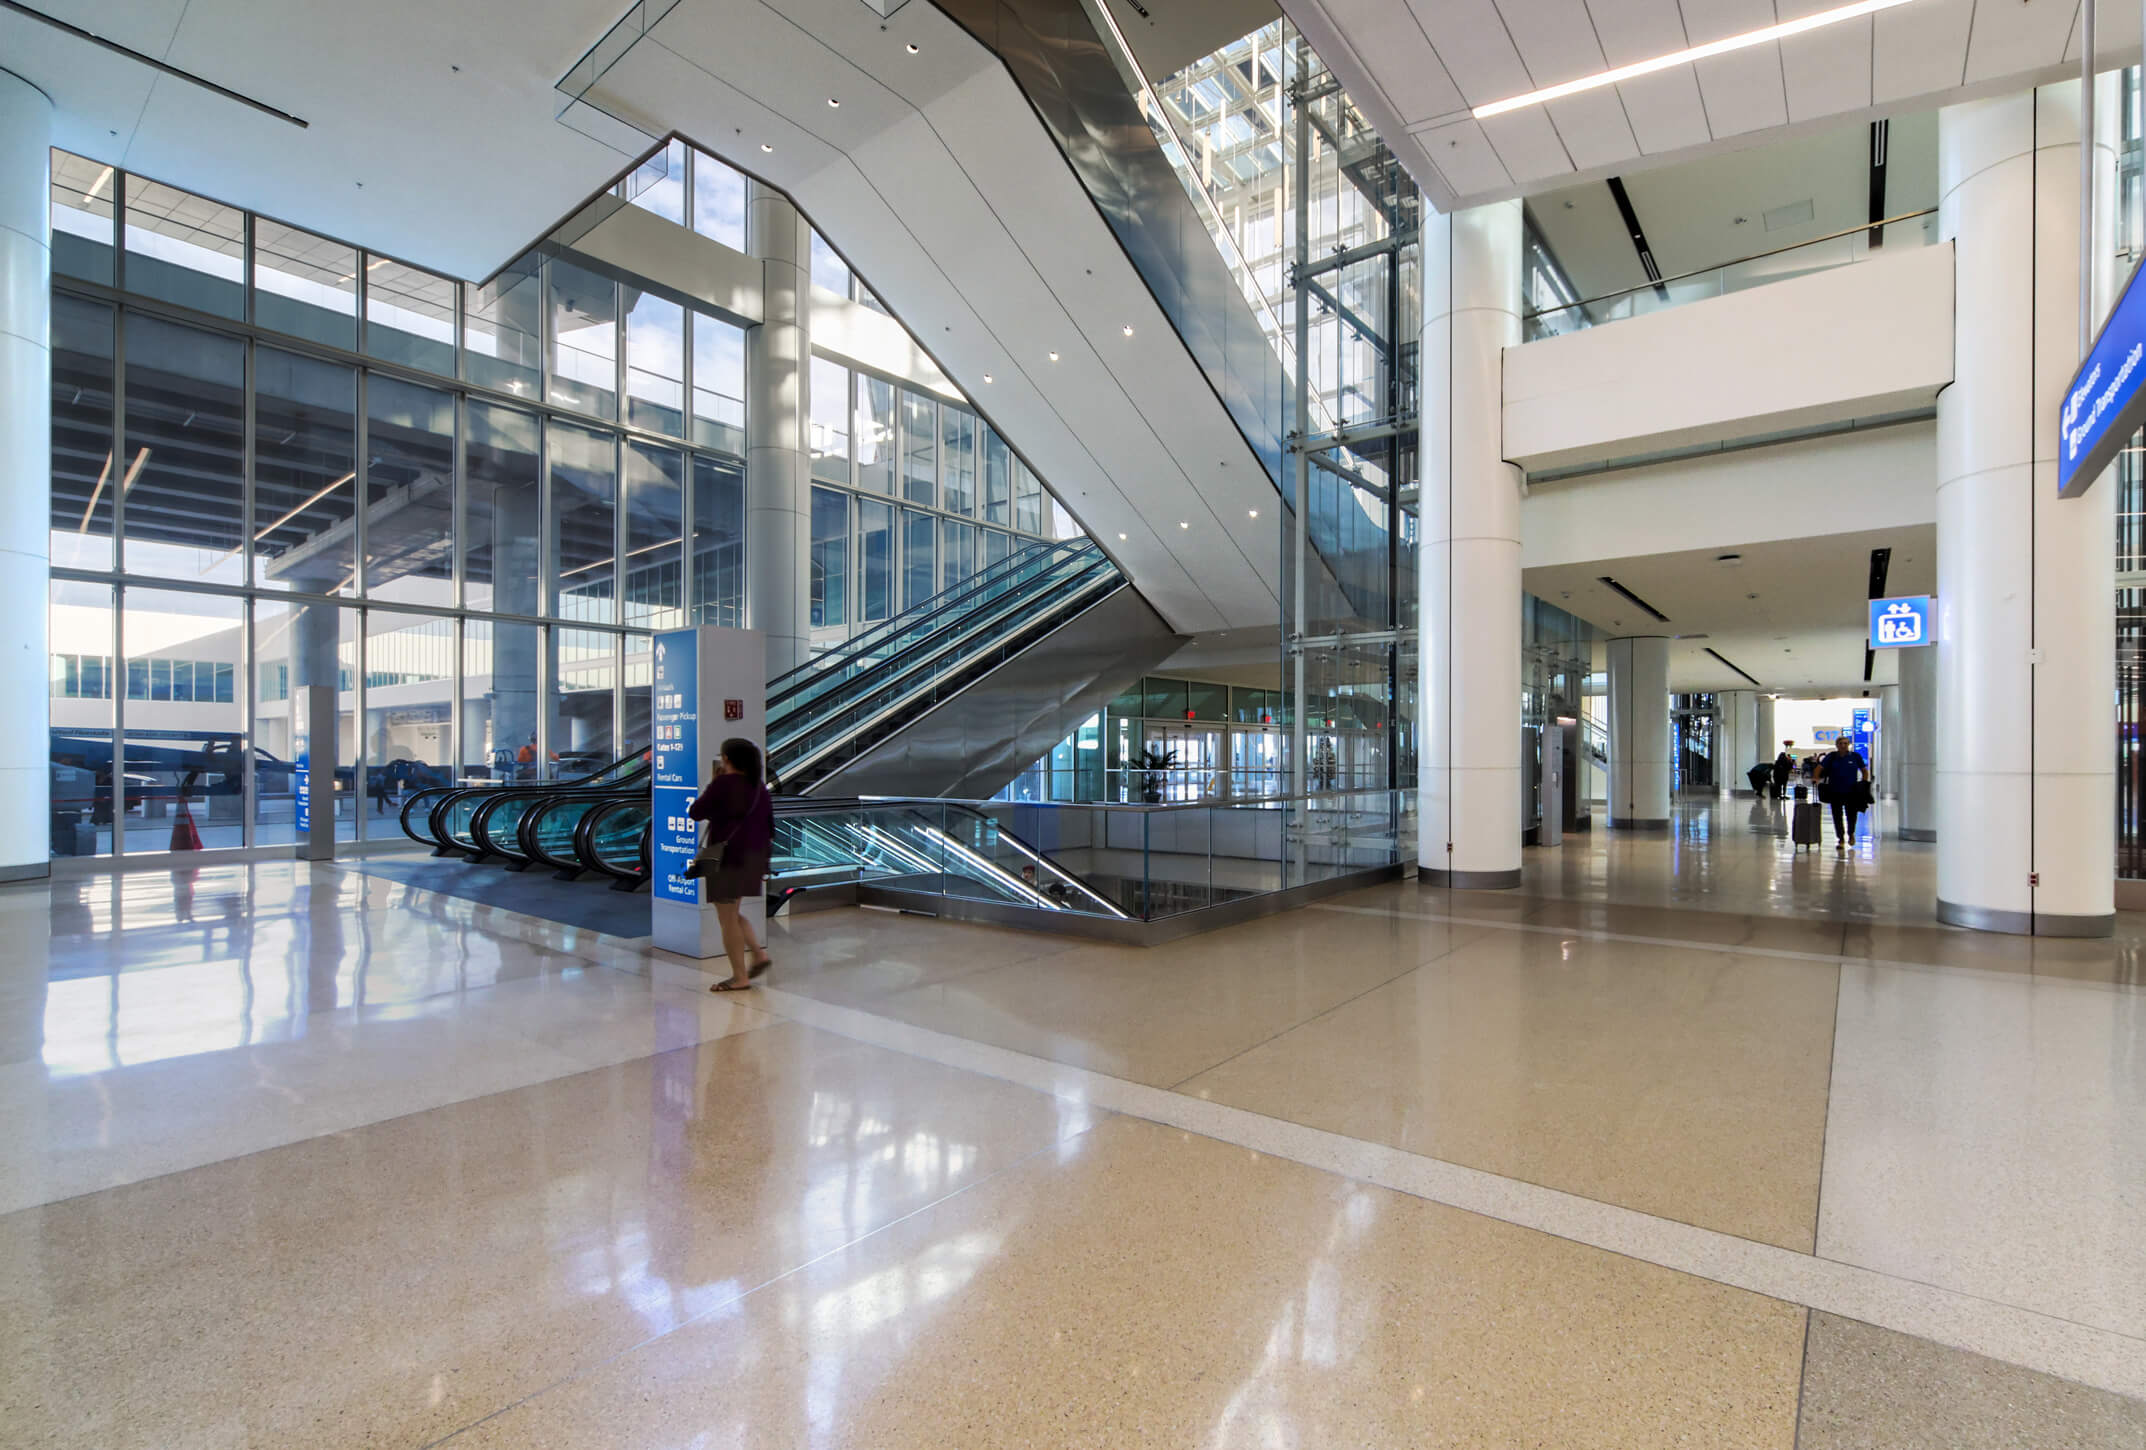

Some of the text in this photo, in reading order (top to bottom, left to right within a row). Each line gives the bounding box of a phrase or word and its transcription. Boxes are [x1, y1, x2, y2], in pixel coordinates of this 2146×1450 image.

[675, 834, 695, 845] Ground
[660, 842, 695, 855] Transportation
[668, 884, 696, 897] Rental Cars
